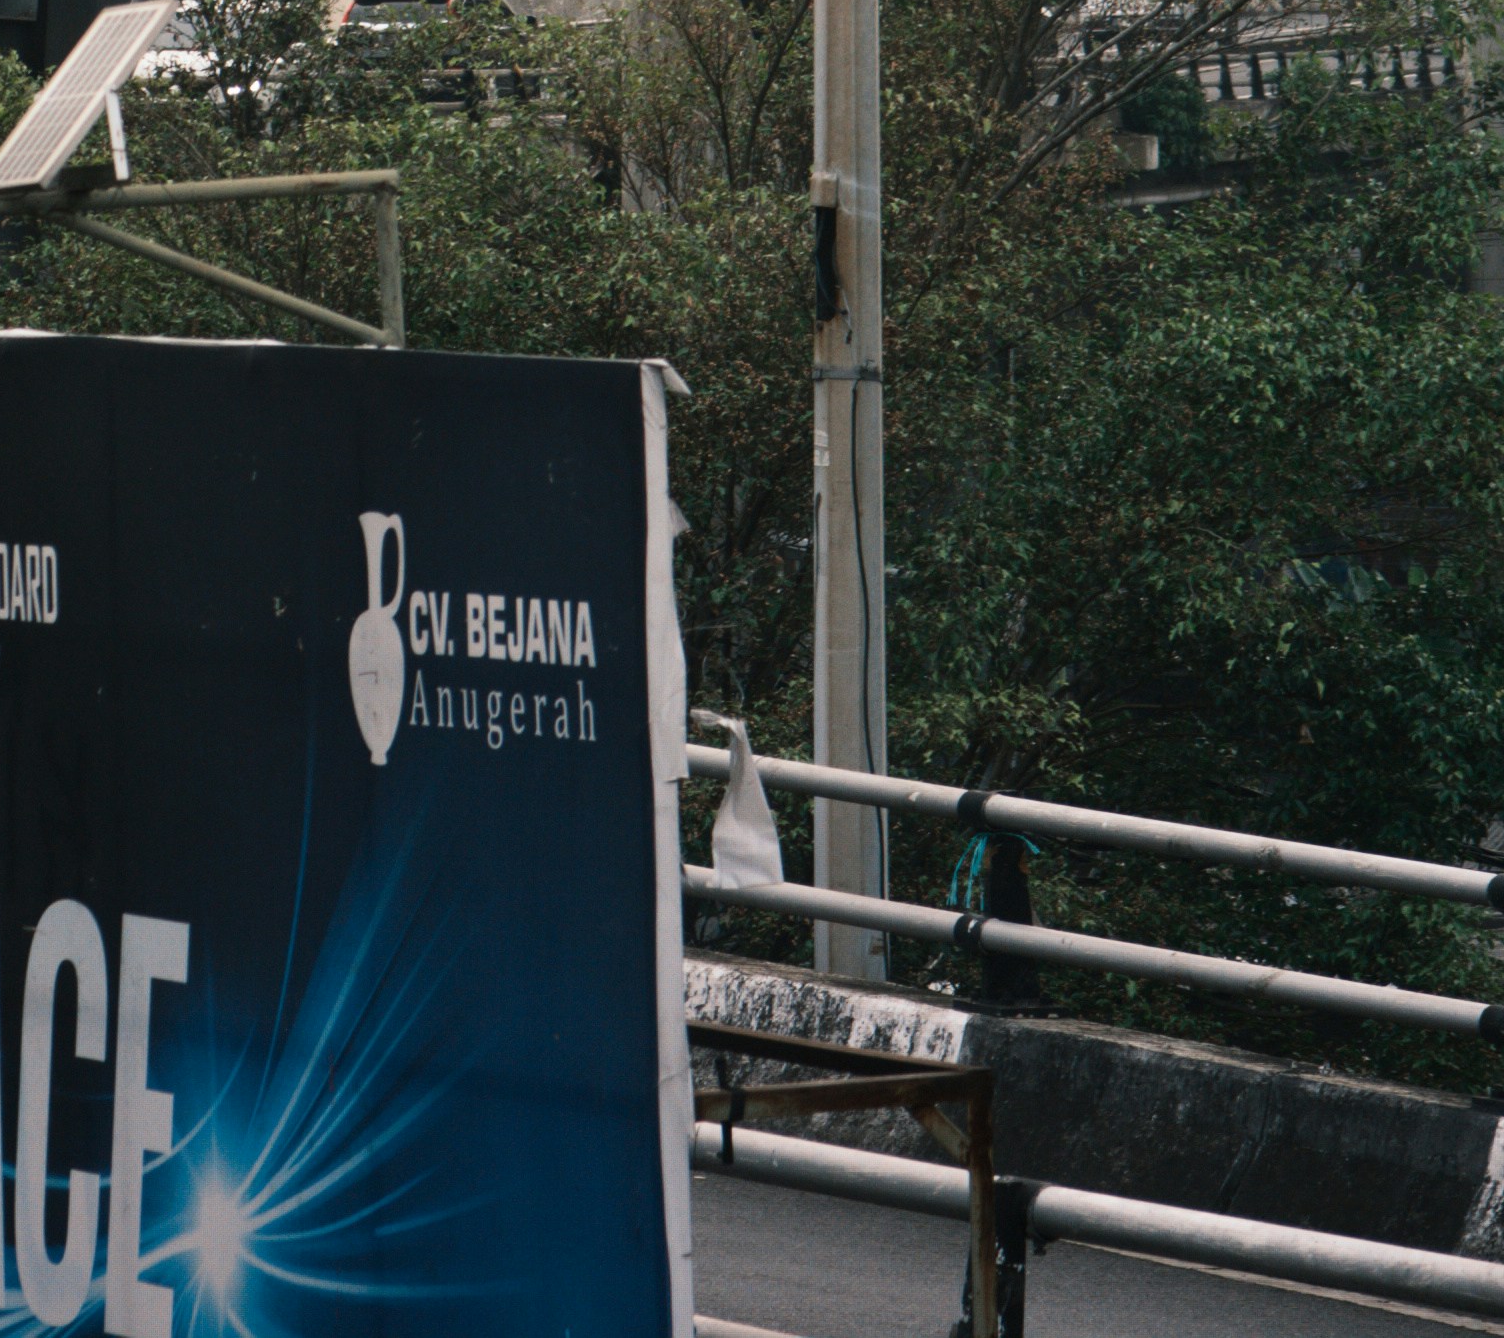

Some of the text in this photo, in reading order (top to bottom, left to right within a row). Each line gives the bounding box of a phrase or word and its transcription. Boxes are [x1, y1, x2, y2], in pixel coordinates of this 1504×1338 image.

[408, 590, 597, 668] CV. BEJANA
[408, 669, 597, 750] Anugerah
